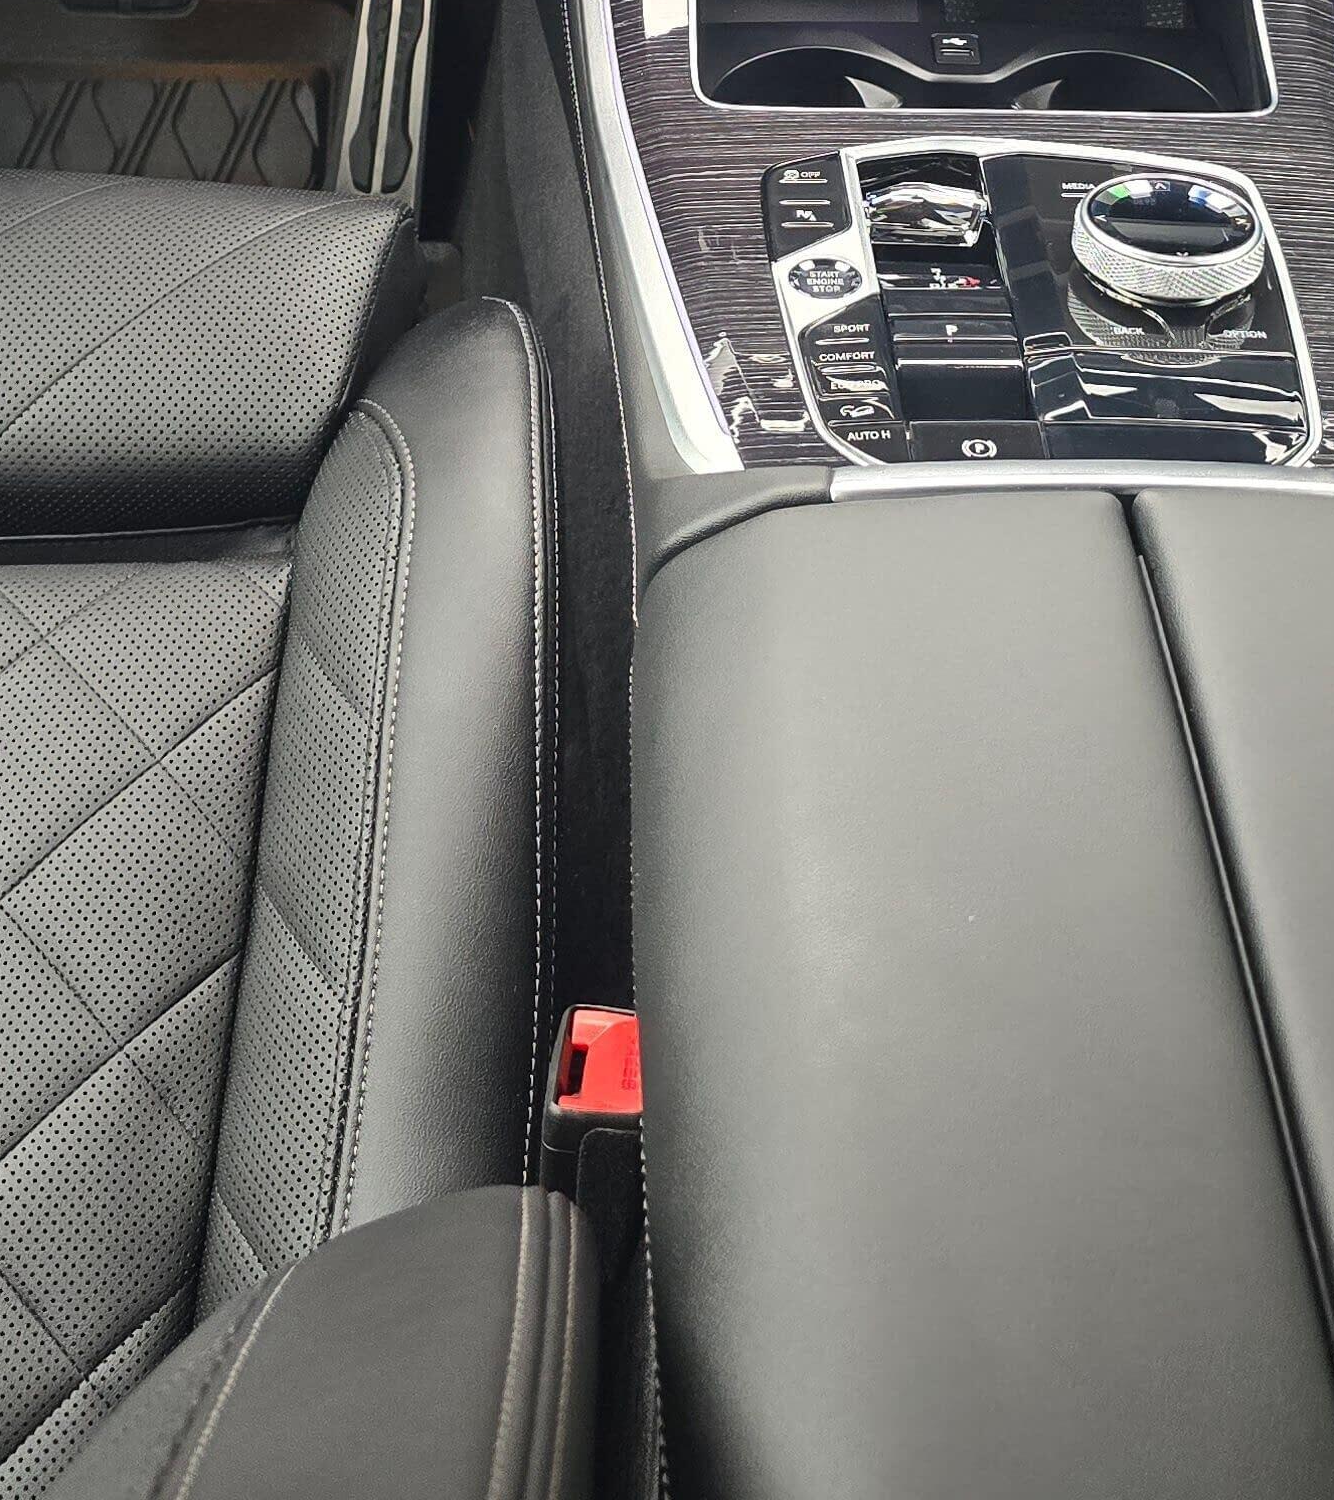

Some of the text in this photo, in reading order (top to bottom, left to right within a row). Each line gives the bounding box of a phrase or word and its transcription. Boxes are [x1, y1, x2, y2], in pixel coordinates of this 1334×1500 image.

[809, 270, 840, 278] START
[807, 278, 844, 286] ENGINE
[812, 285, 840, 293] STOP
[833, 323, 871, 333] SPORT
[1113, 326, 1146, 336] BACK
[1223, 329, 1268, 339] OPTION
[818, 351, 875, 361] COMFORT
[847, 429, 892, 441] AUTO H
